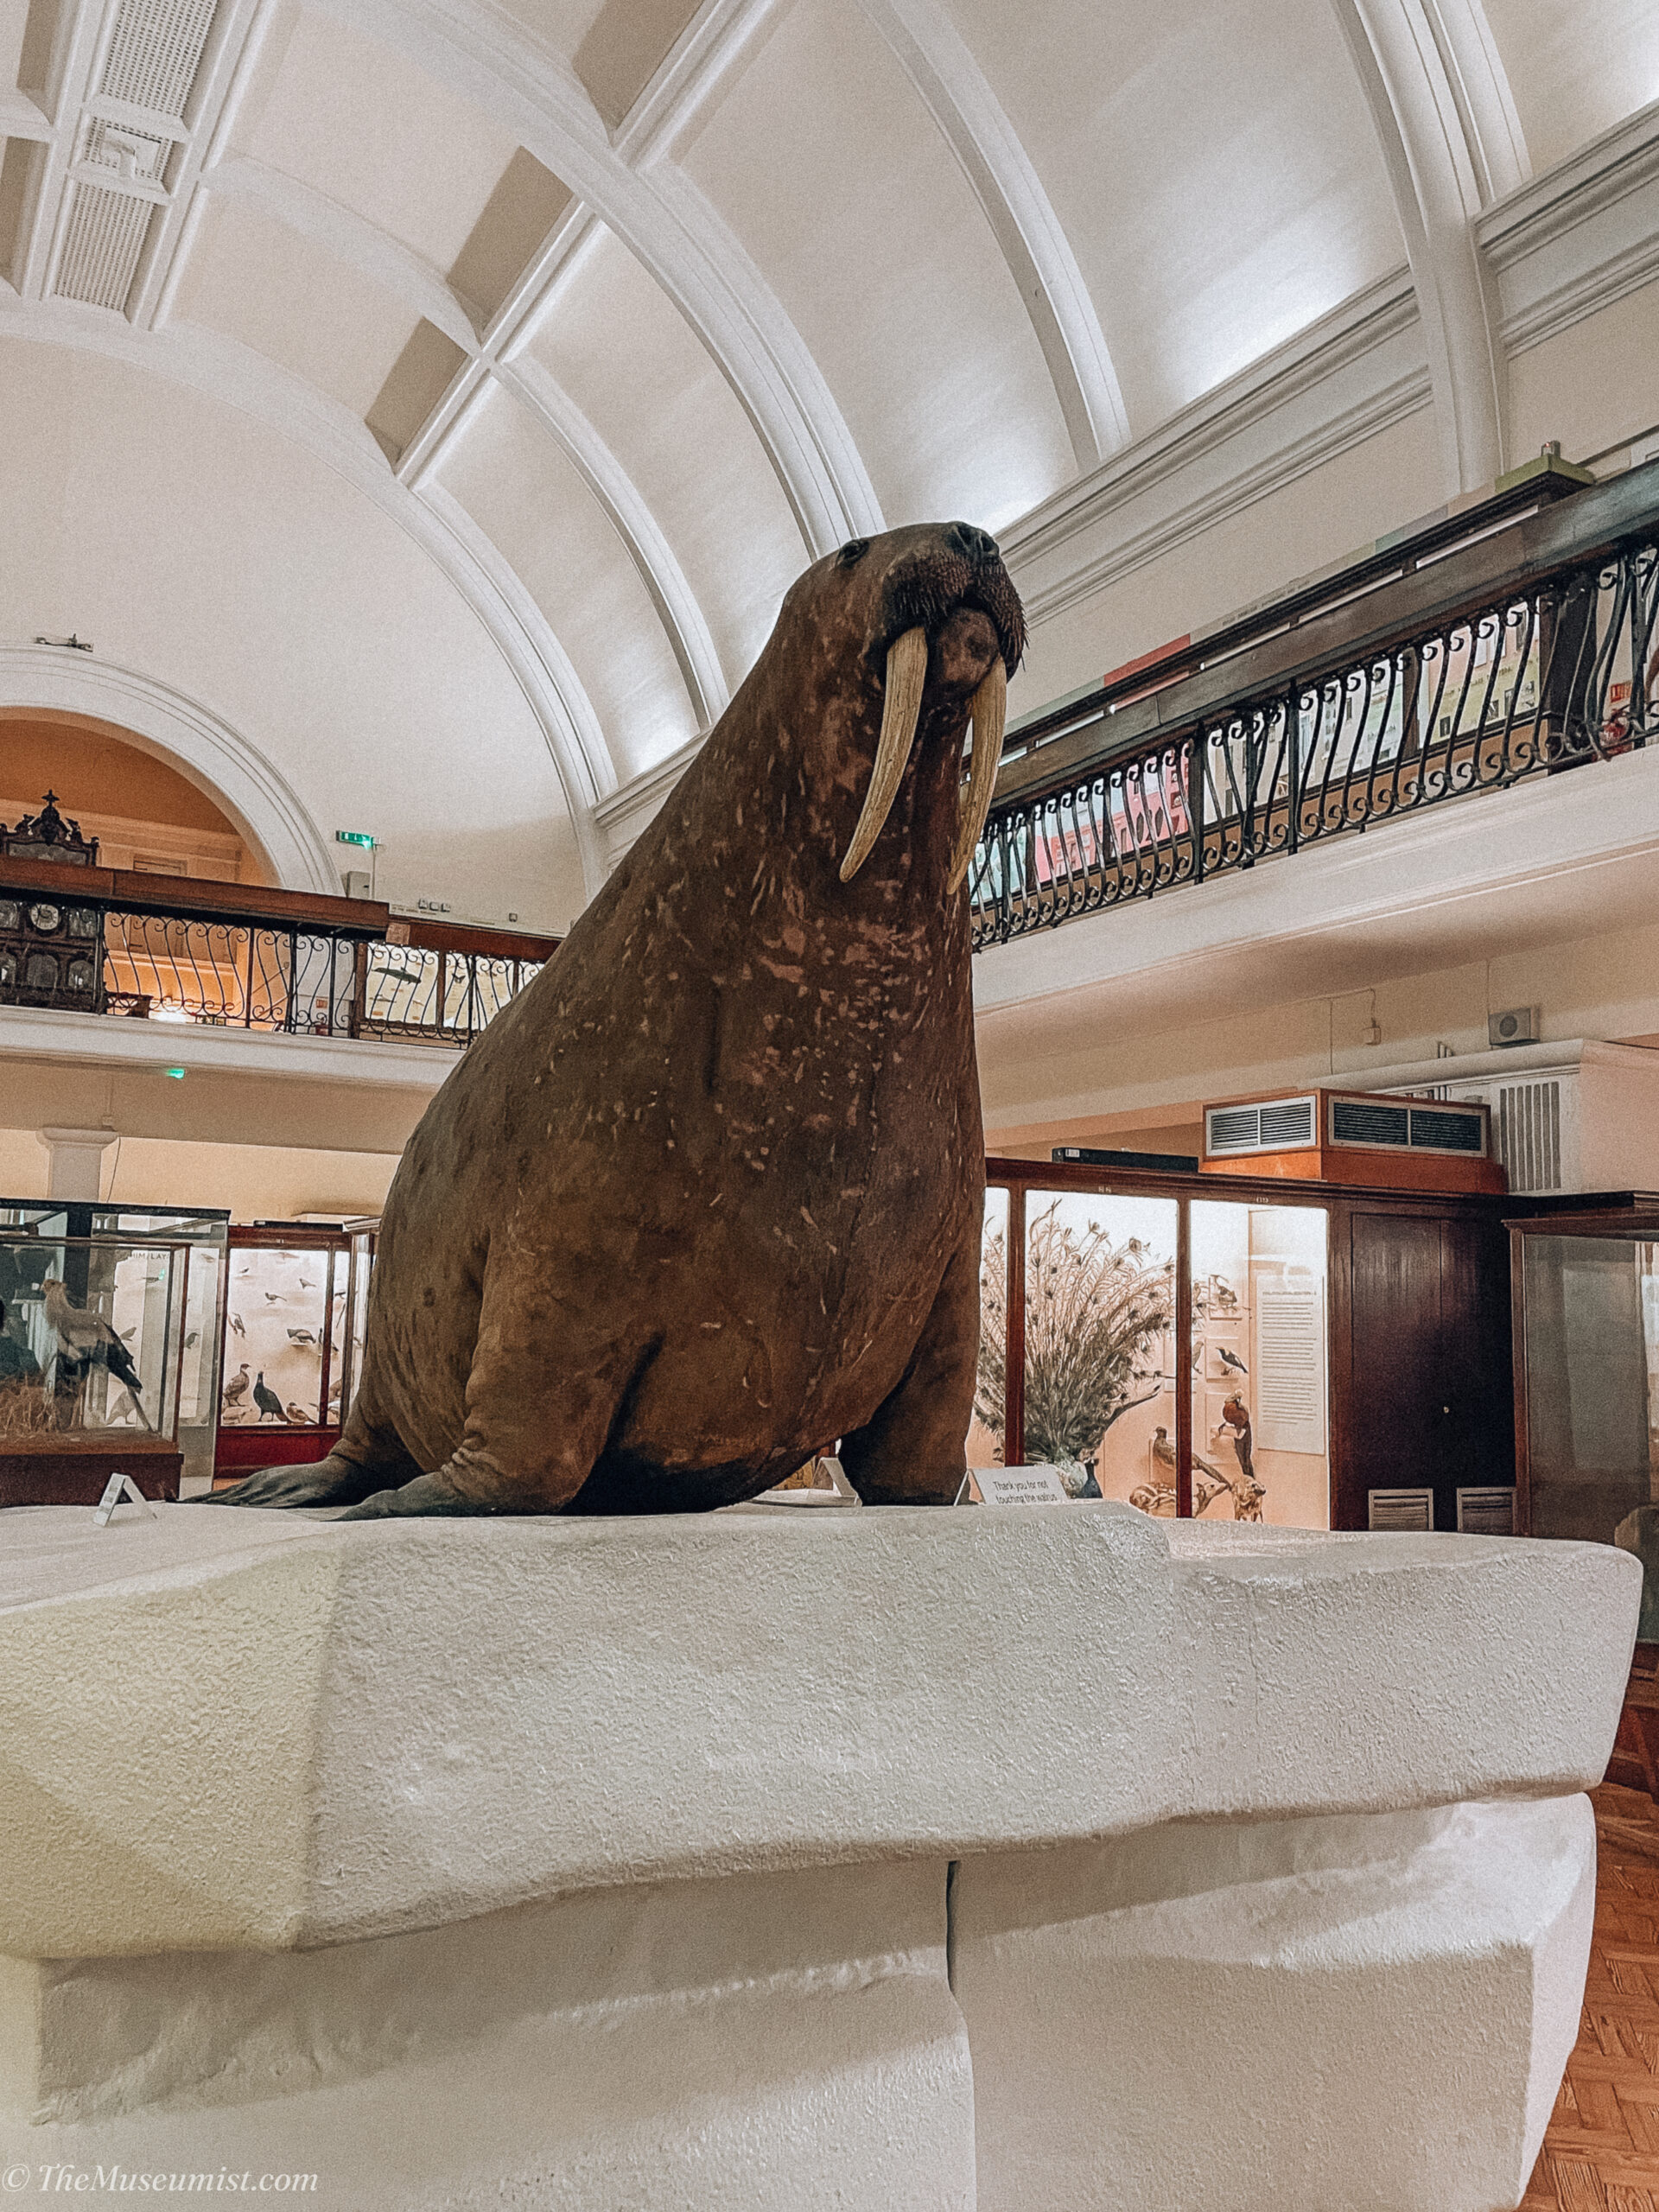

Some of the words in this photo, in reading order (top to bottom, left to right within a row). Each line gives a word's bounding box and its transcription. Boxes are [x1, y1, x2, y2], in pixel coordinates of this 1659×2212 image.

[992, 1480, 1014, 1491] Thank
[1014, 1483, 1027, 1491] you
[1027, 1480, 1036, 1489] for
[1037, 1480, 1049, 1489] not
[995, 1495, 1026, 1503] touching
[1025, 1493, 1036, 1503] the
